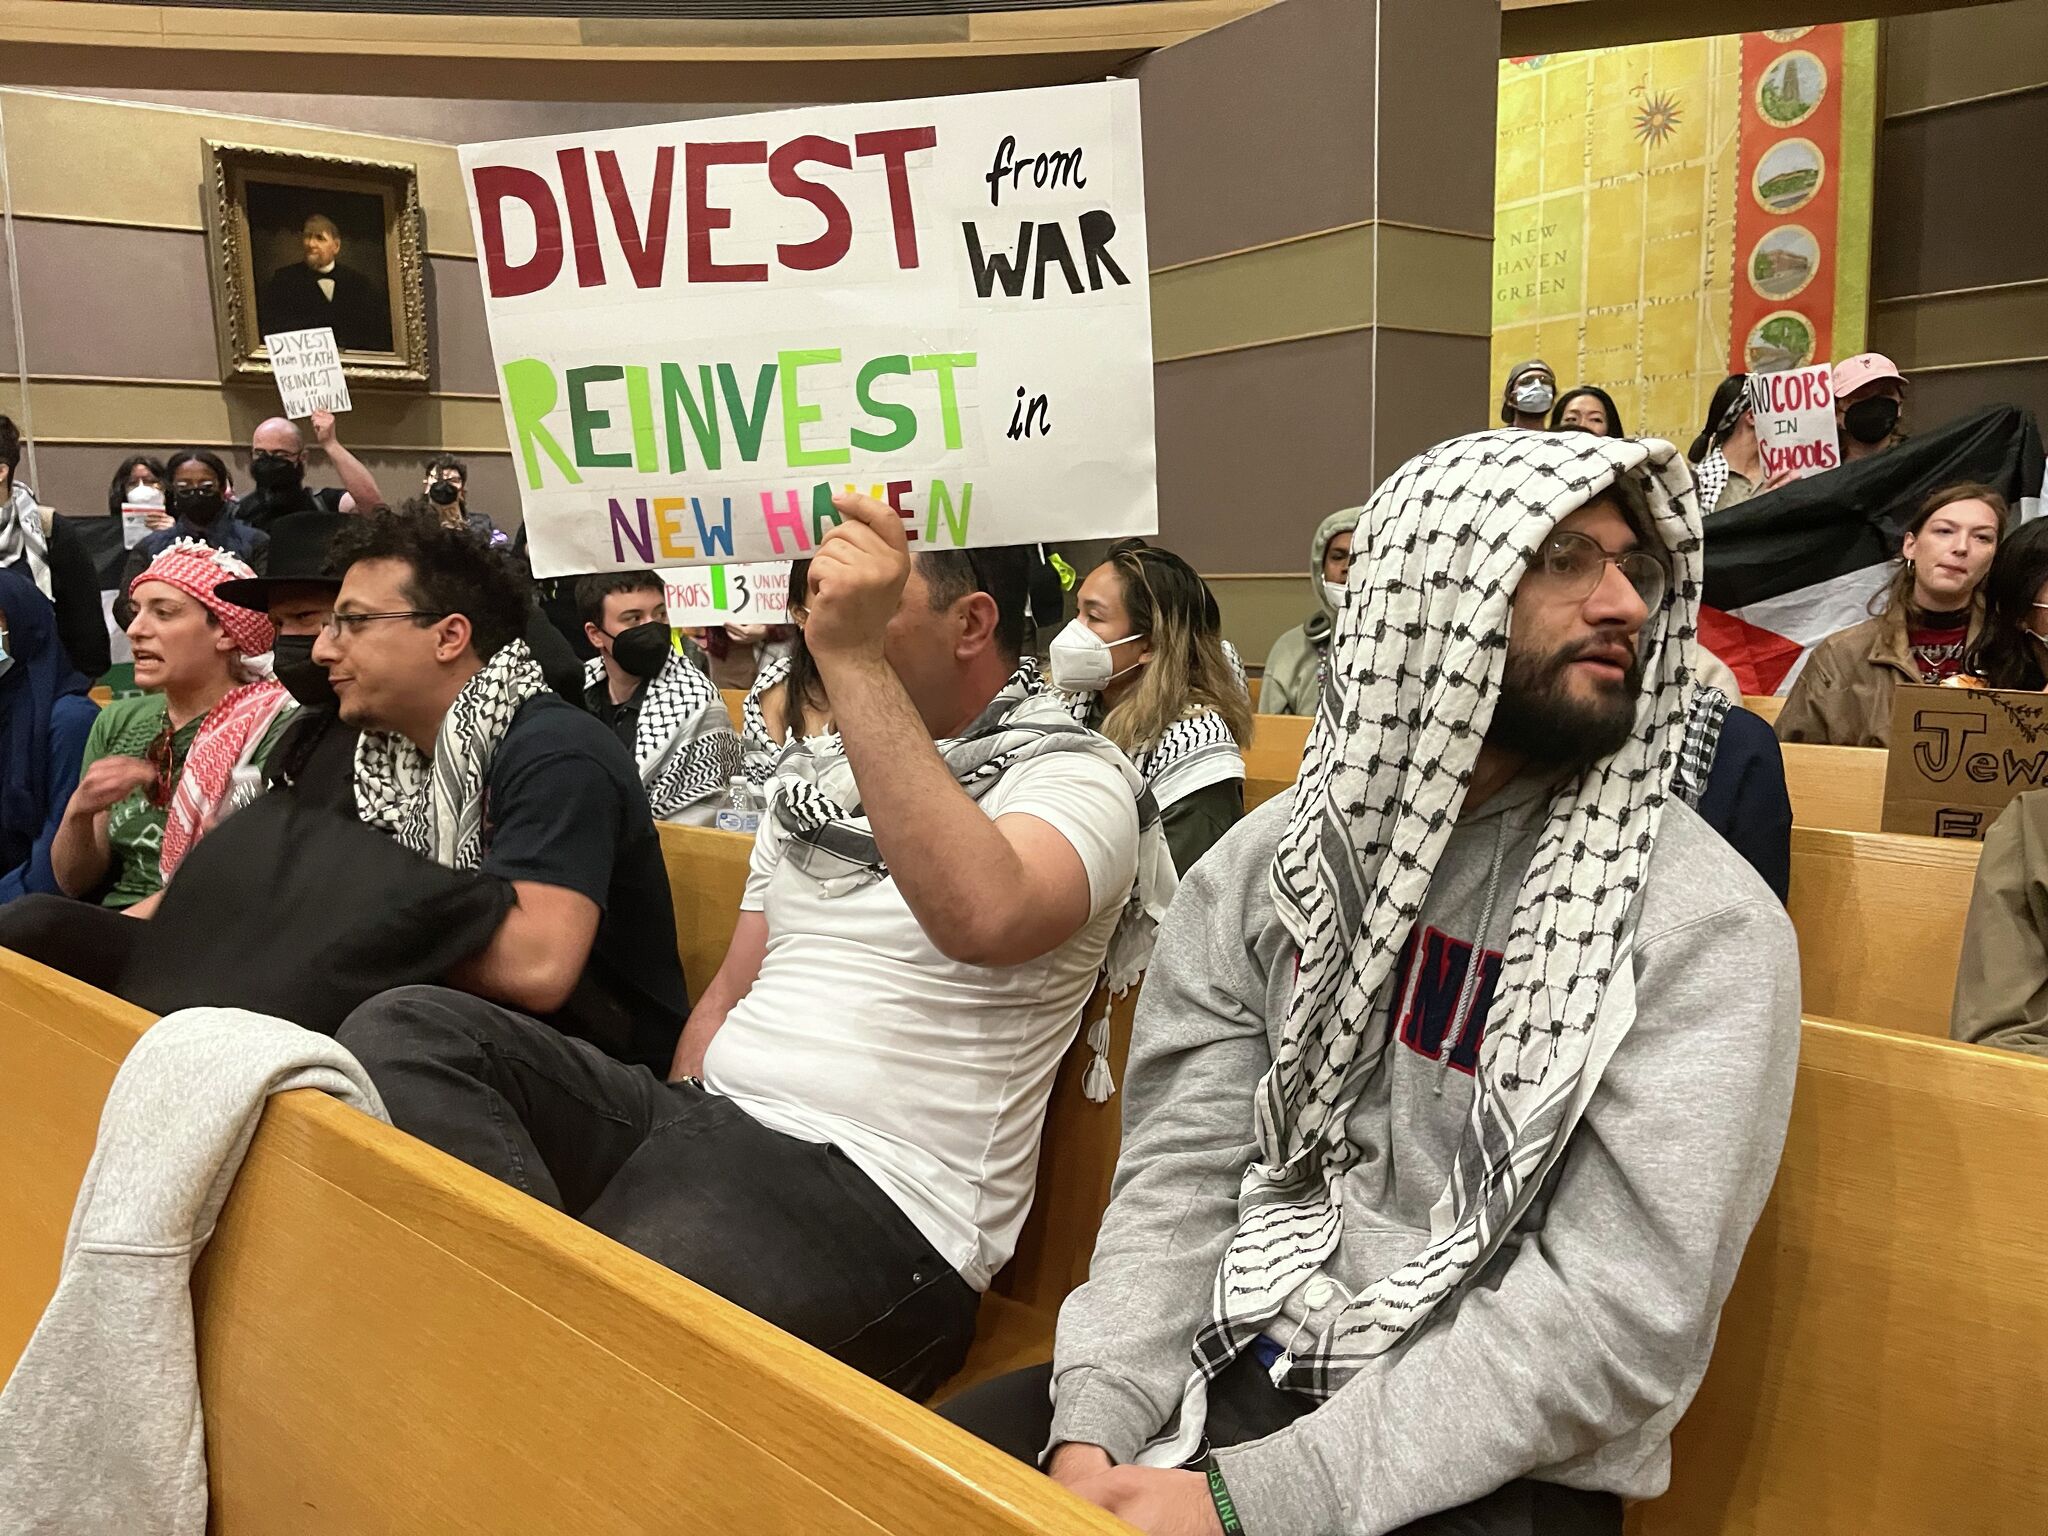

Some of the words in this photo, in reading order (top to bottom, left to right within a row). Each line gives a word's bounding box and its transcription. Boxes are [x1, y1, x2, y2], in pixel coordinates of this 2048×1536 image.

[473, 126, 936, 298] DIVEST
[987, 135, 1086, 206] from
[1510, 224, 1557, 247] NEW
[962, 210, 1131, 300] WAR
[1497, 249, 1567, 276] HAVEN
[1497, 278, 1565, 302] GREEN
[268, 330, 332, 355] DIVEST
[300, 350, 334, 368] DEATH
[280, 366, 338, 392] REINVEST
[1750, 376, 1771, 415] NO
[1771, 371, 1831, 413] COPS
[502, 348, 977, 490] REINVEST
[1006, 387, 1051, 441] in
[1774, 417, 1798, 435] IN
[608, 496, 733, 563] NEW
[760, 479, 973, 557] HAEN
[732, 575, 750, 614] 3
[753, 574, 790, 589] UNIVE
[665, 583, 710, 609] PROFS
[756, 592, 789, 613] PRESI
[1914, 710, 2048, 789] Jew
[1209, 1471, 1238, 1533] ESTINE
